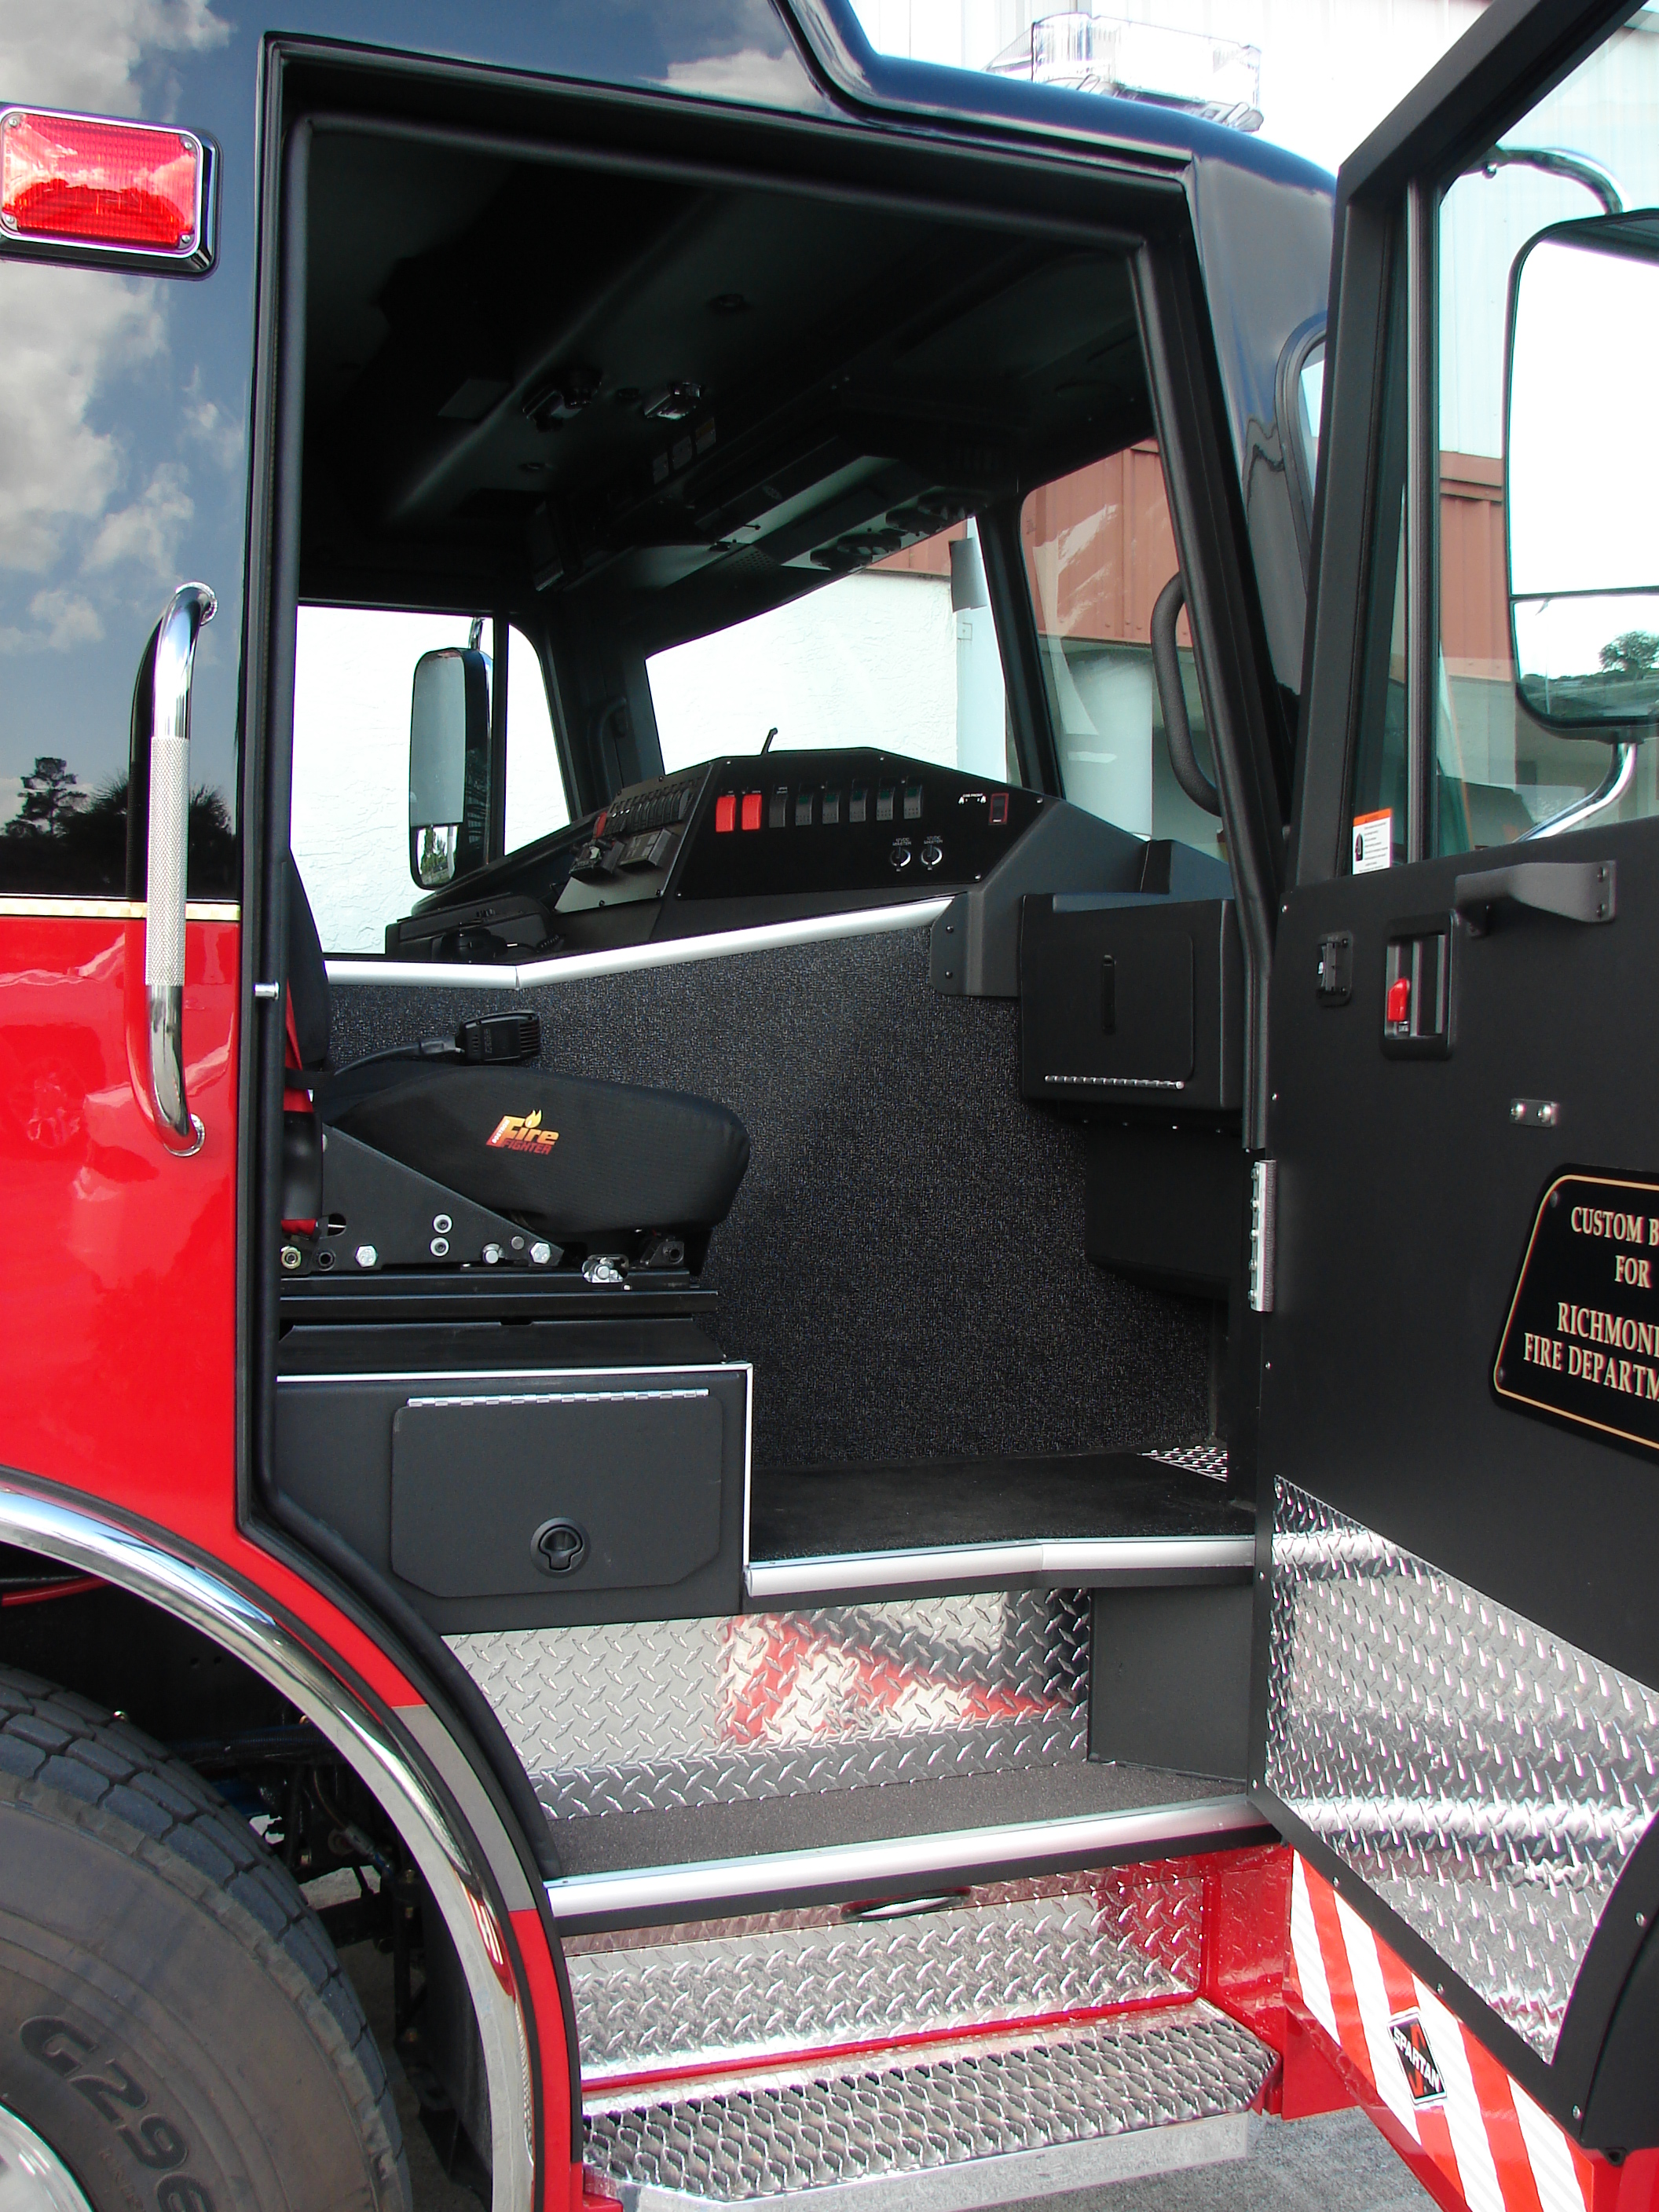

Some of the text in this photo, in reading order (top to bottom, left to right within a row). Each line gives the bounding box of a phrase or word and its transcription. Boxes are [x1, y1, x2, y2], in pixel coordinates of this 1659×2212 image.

[486, 1109, 559, 1148] Fire
[503, 1138, 552, 1155] FIGHTER
[1571, 1206, 1643, 1243] CUSTOM
[1615, 1255, 1651, 1288] FOR
[1524, 1332, 1562, 1371] FIRE
[1393, 2026, 1441, 2093] SPARTAN
